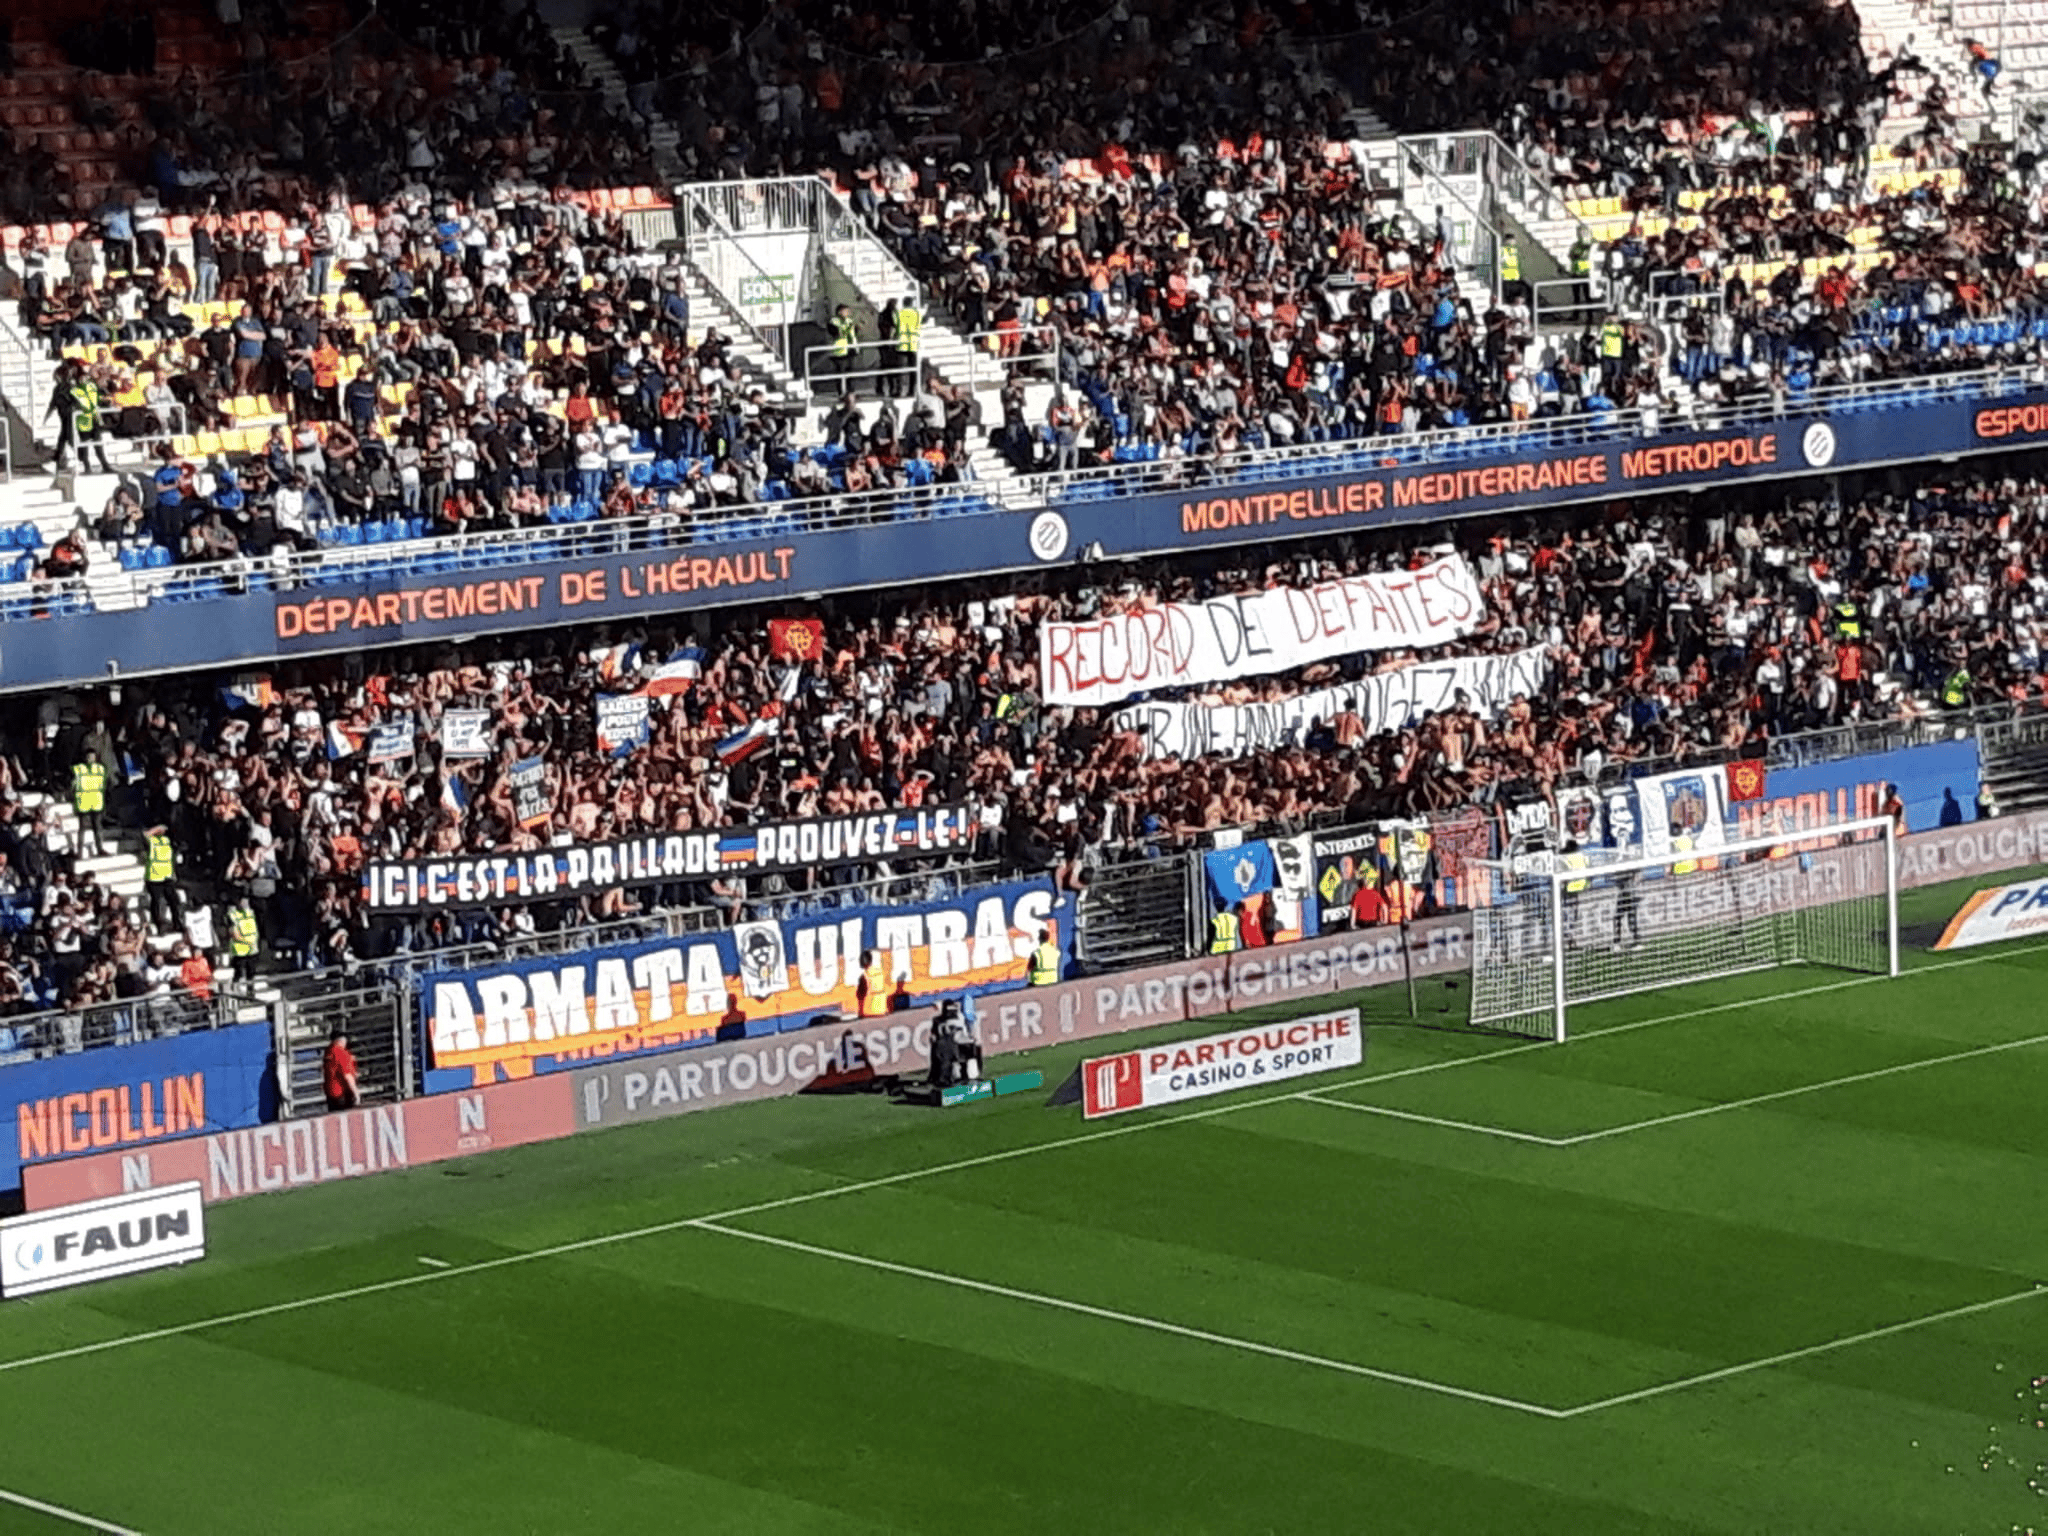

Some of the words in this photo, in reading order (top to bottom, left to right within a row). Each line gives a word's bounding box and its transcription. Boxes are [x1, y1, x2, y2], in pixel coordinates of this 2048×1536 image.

[1182, 482, 1384, 532] MONTPELLIER
[1392, 455, 1607, 507] MEDITERRANEE
[1621, 435, 1777, 479] METROPOLE
[277, 576, 545, 638] DÉPARTEMENT
[560, 570, 607, 605] DE
[621, 547, 795, 598] L'HÉRAULT
[1048, 603, 1194, 694] RECORD
[1206, 597, 1273, 666] DE
[369, 865, 418, 907] ICI
[427, 858, 508, 904] C'EST
[517, 854, 556, 897] LA
[567, 834, 748, 888] PAILLADE...
[433, 943, 728, 1051] ARMATA
[796, 890, 1052, 996] ULTRAS
[623, 1001, 1044, 1111] PARTOUCHESPOT.FR
[1150, 1017, 1352, 1075] PARTOUCHE
[1169, 1062, 1247, 1092] CASINO
[1252, 1058, 1266, 1076] &
[1273, 1044, 1335, 1071] SPORT
[18, 1072, 204, 1159] NICOLLIN
[207, 1104, 407, 1198] NICOLLIN
[458, 1094, 486, 1134] N
[54, 1209, 190, 1262] FAUN
